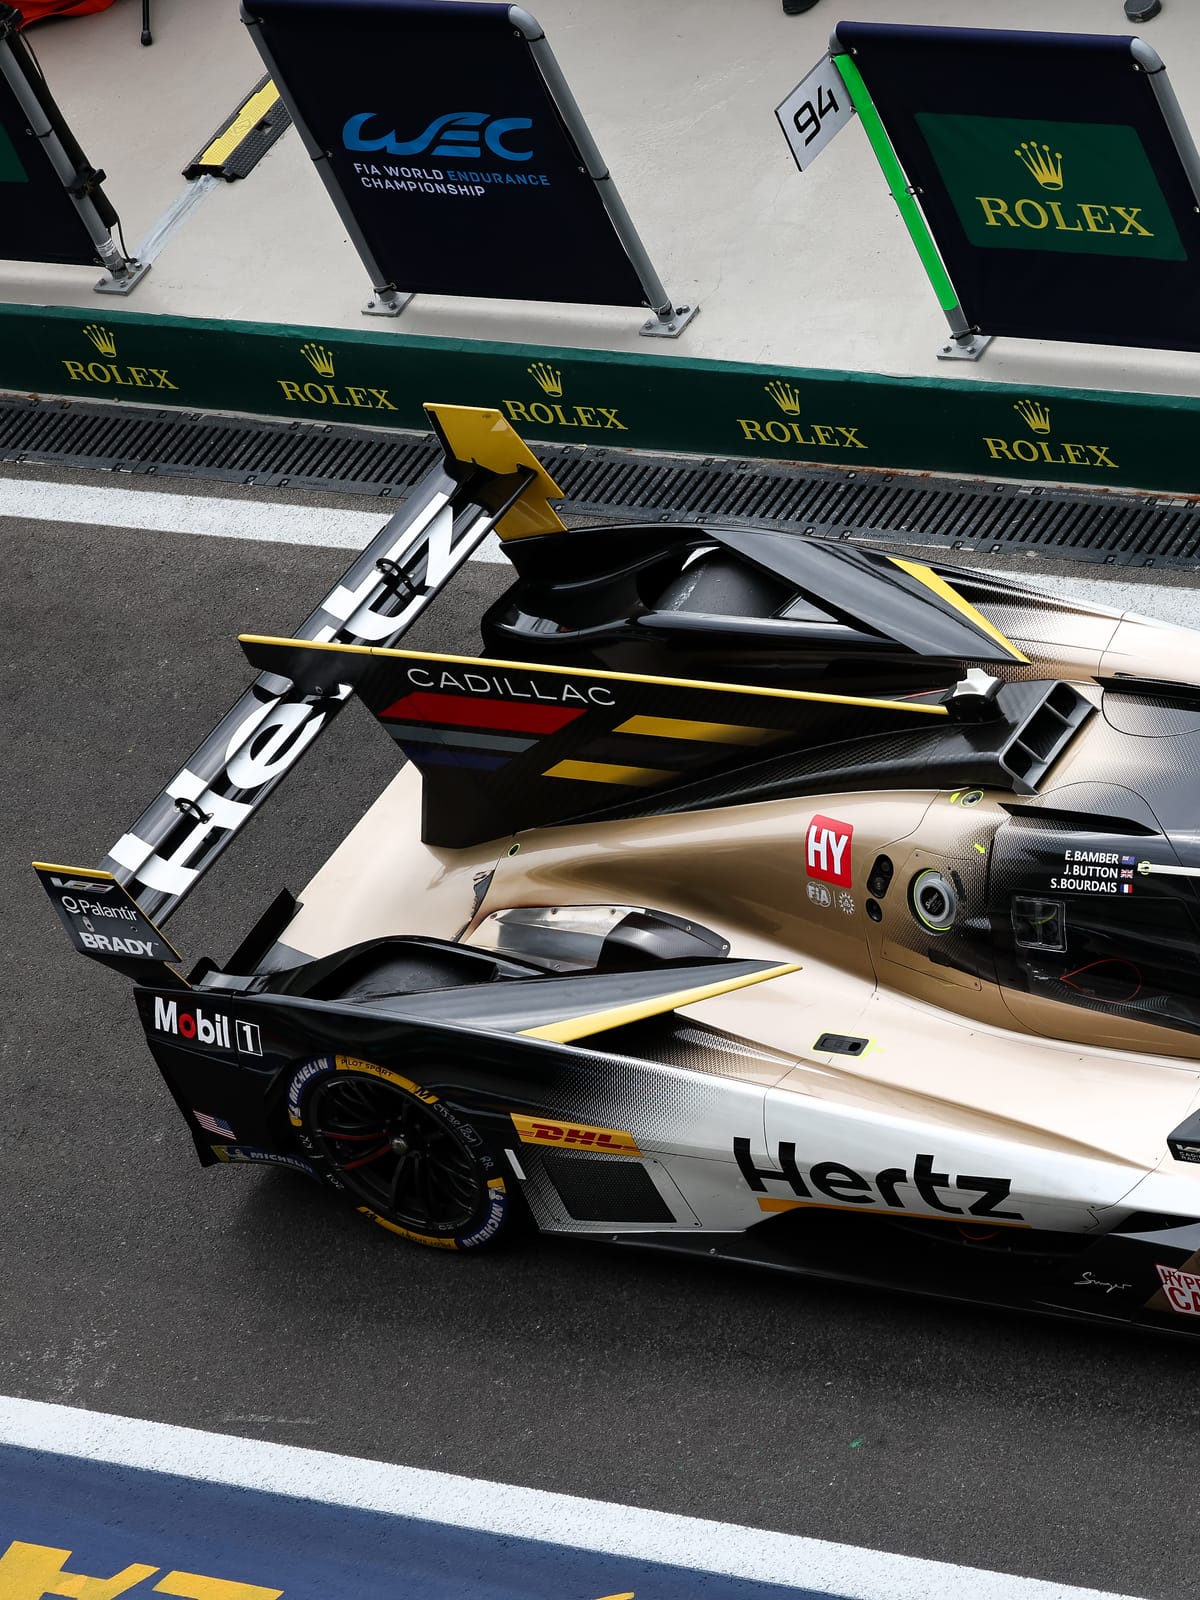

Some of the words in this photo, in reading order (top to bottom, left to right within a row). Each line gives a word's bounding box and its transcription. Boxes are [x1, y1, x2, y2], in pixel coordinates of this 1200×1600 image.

[793, 85, 840, 147] 94
[342, 111, 534, 162] WEC
[353, 162, 382, 176] FIA
[383, 165, 444, 181] WORLD
[446, 170, 551, 187] ENDURANCE
[360, 176, 486, 197] CHAMPIONSHIP
[975, 196, 1154, 238] ROLEX
[63, 360, 179, 391] ROLEX
[277, 379, 399, 411] ROLEX
[502, 400, 629, 432] ROLEX
[738, 418, 869, 450] ROLEX
[982, 436, 1120, 469] ROLEX
[406, 667, 617, 706] CADILLAC
[807, 825, 849, 875] HY
[807, 884, 830, 903] FIA
[1050, 877, 1118, 894] S.BOURDAIS
[78, 899, 137, 921] Palantir
[79, 931, 154, 957] BRADY
[154, 996, 231, 1049] Mobil
[288, 1057, 329, 1105] MICHELIN
[340, 1058, 364, 1068] PILOT
[364, 1062, 393, 1078] SPORT
[413, 1085, 432, 1101] M
[530, 1123, 623, 1150] DHL
[250, 1151, 314, 1173] MICHELIN
[733, 1136, 1025, 1221] Hertz
[462, 1203, 504, 1248] MICHELIN
